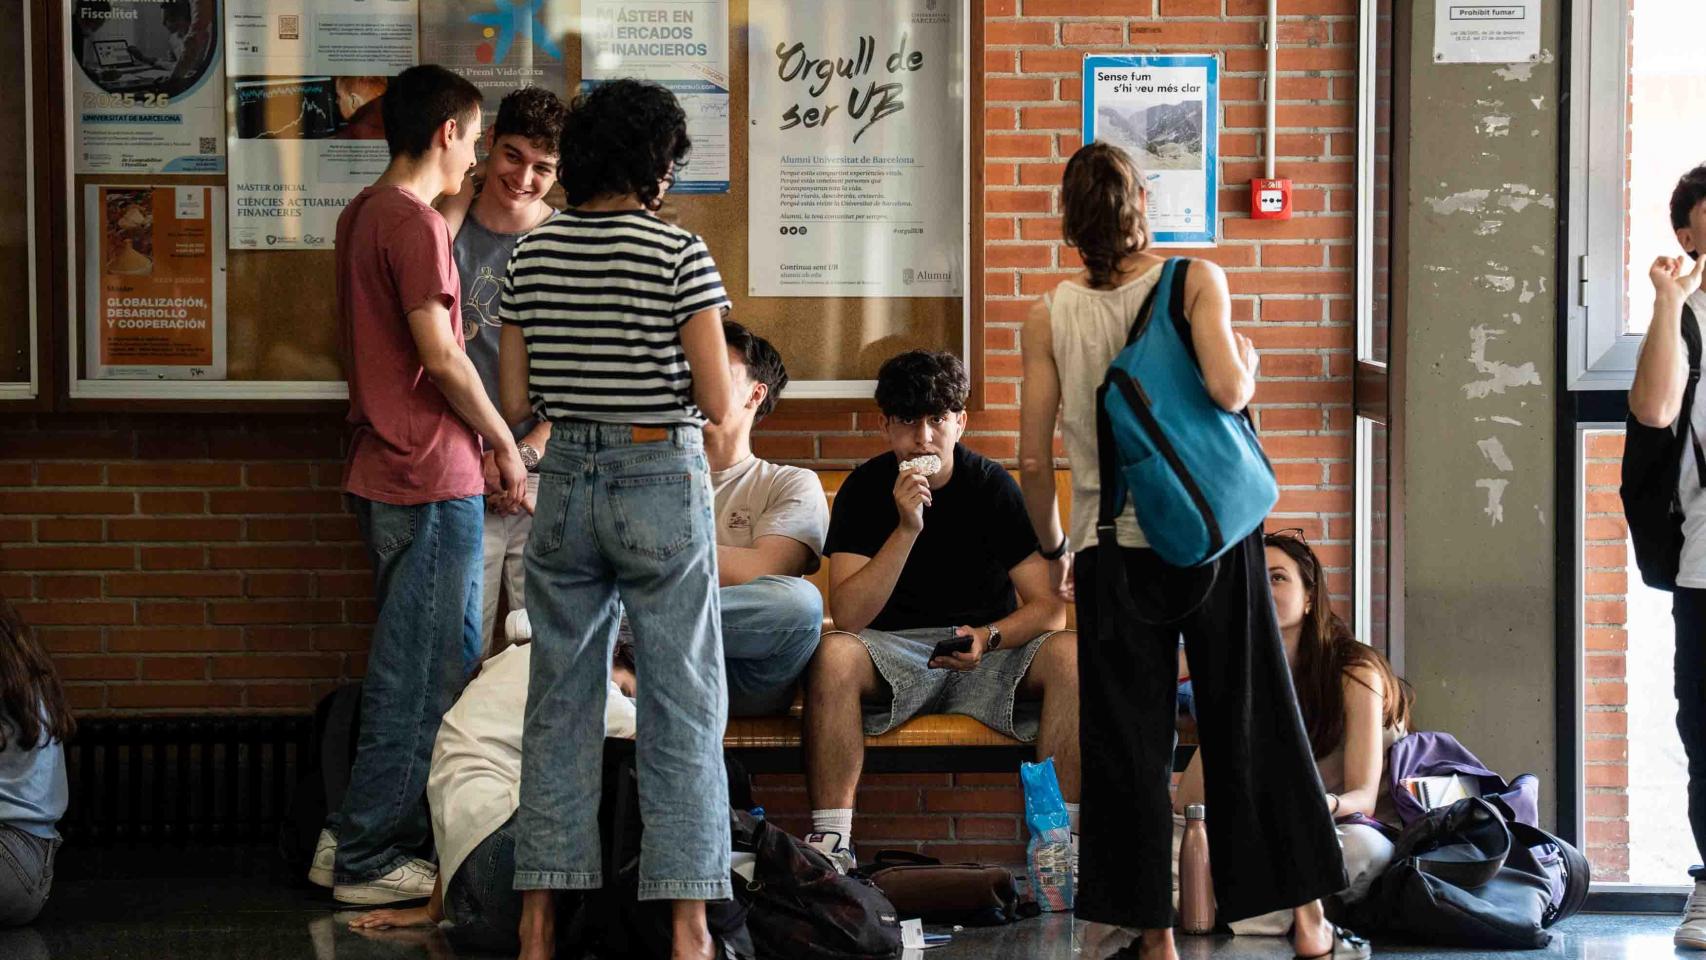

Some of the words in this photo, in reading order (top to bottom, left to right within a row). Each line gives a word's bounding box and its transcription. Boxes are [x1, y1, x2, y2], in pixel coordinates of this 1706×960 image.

[80, 7, 138, 19] Fiscalitat
[673, 10, 693, 23] EN
[776, 35, 875, 98] Orgull
[886, 31, 924, 74] de
[466, 68, 494, 76] Premi
[496, 68, 544, 76] VidaCaixa
[1097, 72, 1128, 81] Sense
[1131, 72, 1152, 81] fum
[474, 81, 518, 89] egurances
[1113, 83, 1132, 93] s'hi
[1157, 83, 1178, 93] més
[1181, 84, 1201, 93] clar
[82, 92, 170, 108] 2025-26
[779, 104, 839, 130] ser
[847, 81, 905, 145] UB
[780, 156, 811, 164] Alumni
[812, 156, 859, 164] Universitat
[860, 156, 871, 164] de
[873, 156, 915, 164] Barcelona
[237, 197, 284, 207] CIÈNCIES
[237, 208, 302, 217] FINANCERES
[917, 270, 952, 279] Alumni
[107, 296, 207, 309] GLOBALIZACIÓN,
[107, 309, 187, 318] DESARROLLO
[107, 319, 114, 328] Y
[118, 317, 206, 329] COOPERACIÓN
